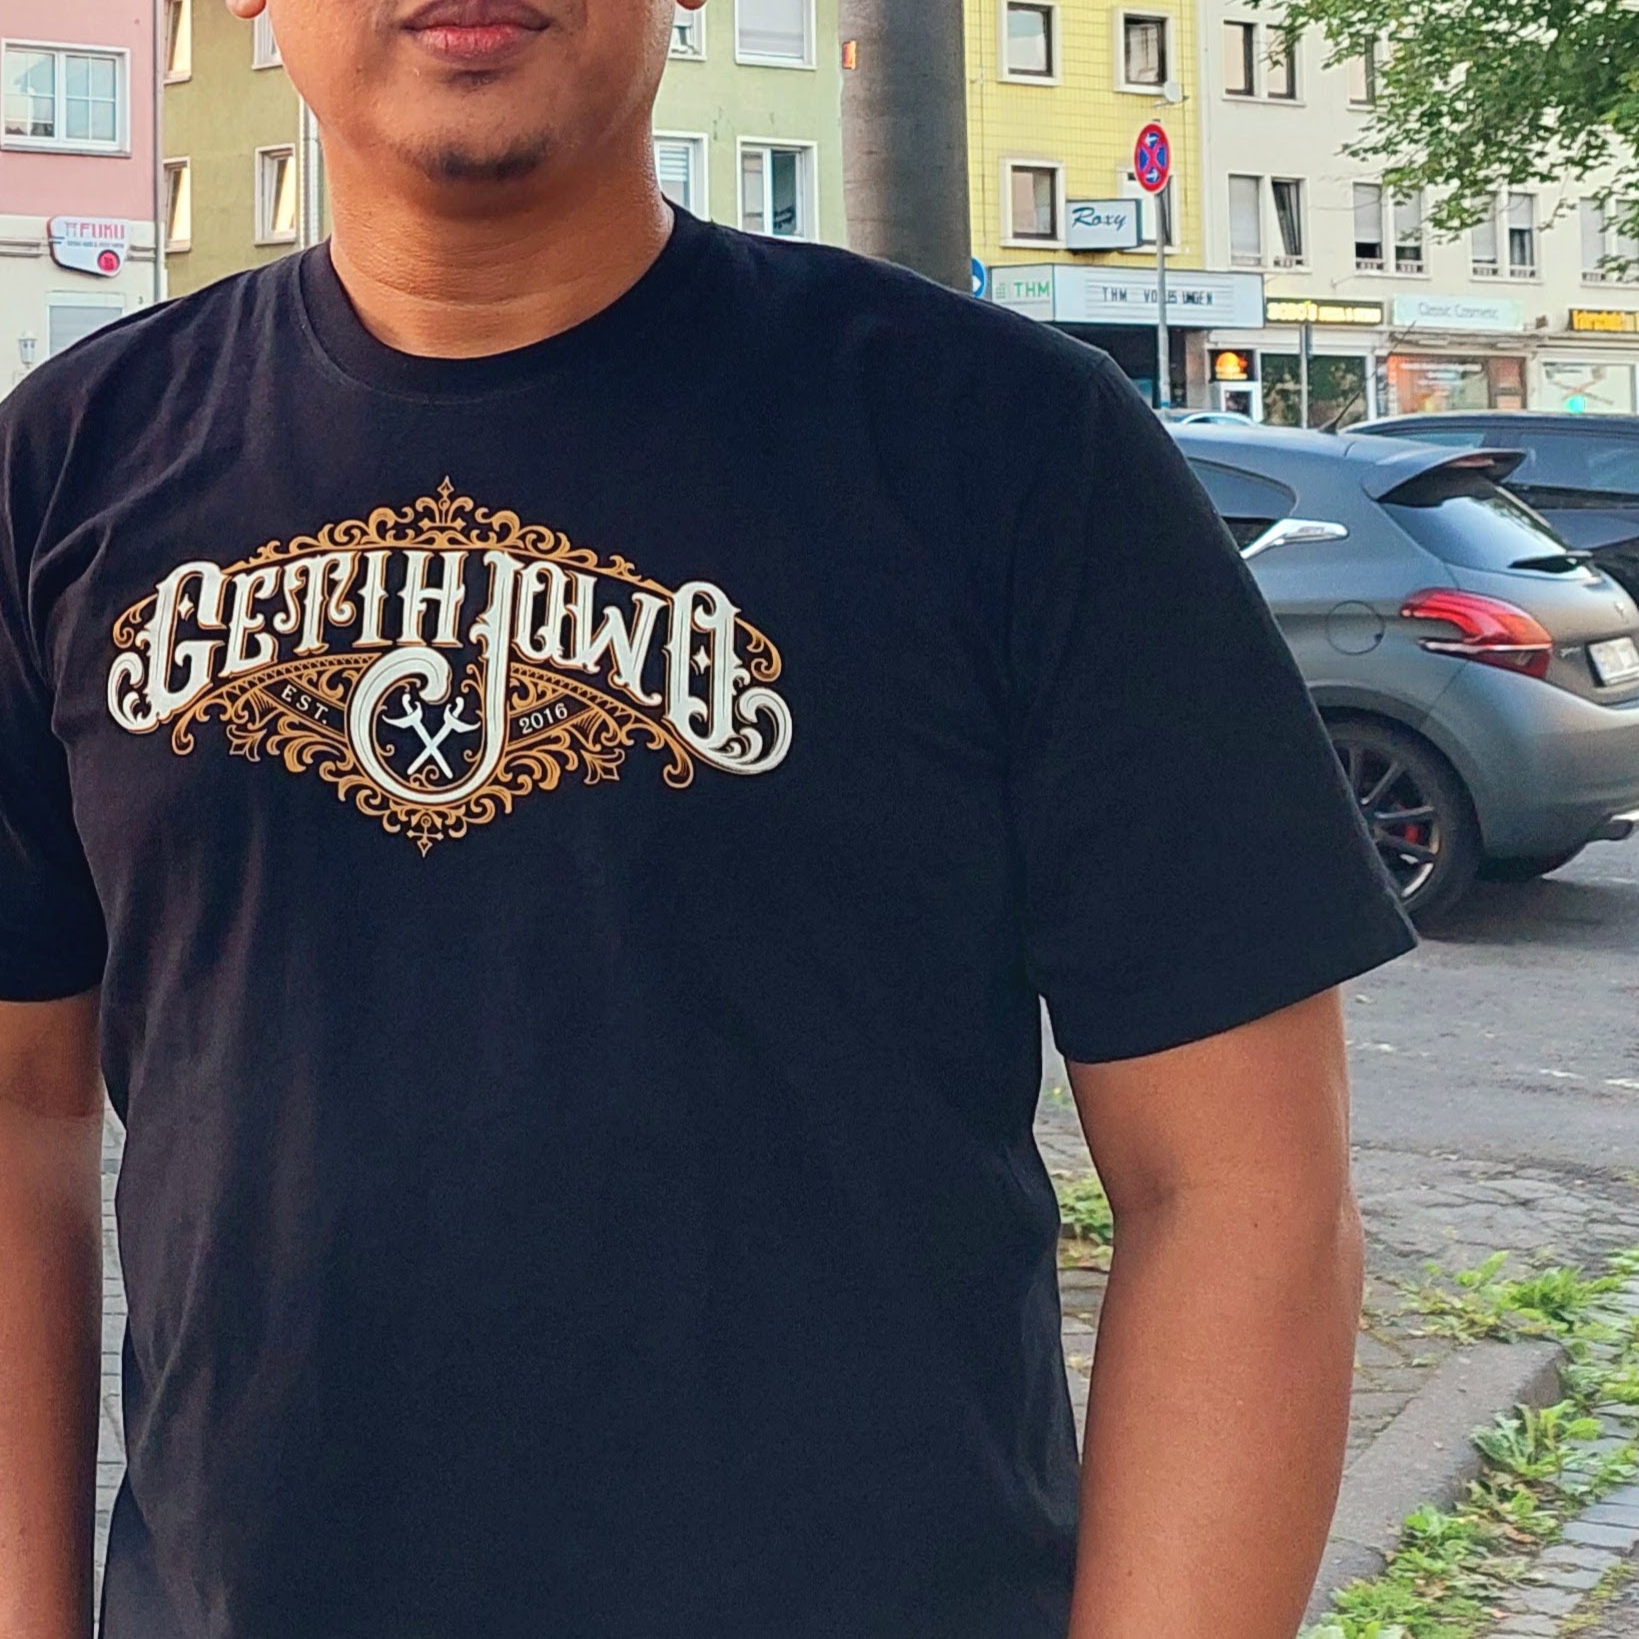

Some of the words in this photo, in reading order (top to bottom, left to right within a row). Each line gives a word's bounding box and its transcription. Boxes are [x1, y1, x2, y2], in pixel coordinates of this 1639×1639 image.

[1071, 206, 1127, 232] Roxy
[79, 222, 125, 240] FUKU
[1013, 281, 1051, 299] THM
[1102, 286, 1128, 302] THM
[280, 683, 330, 726] EST.
[518, 702, 569, 735] 2016
